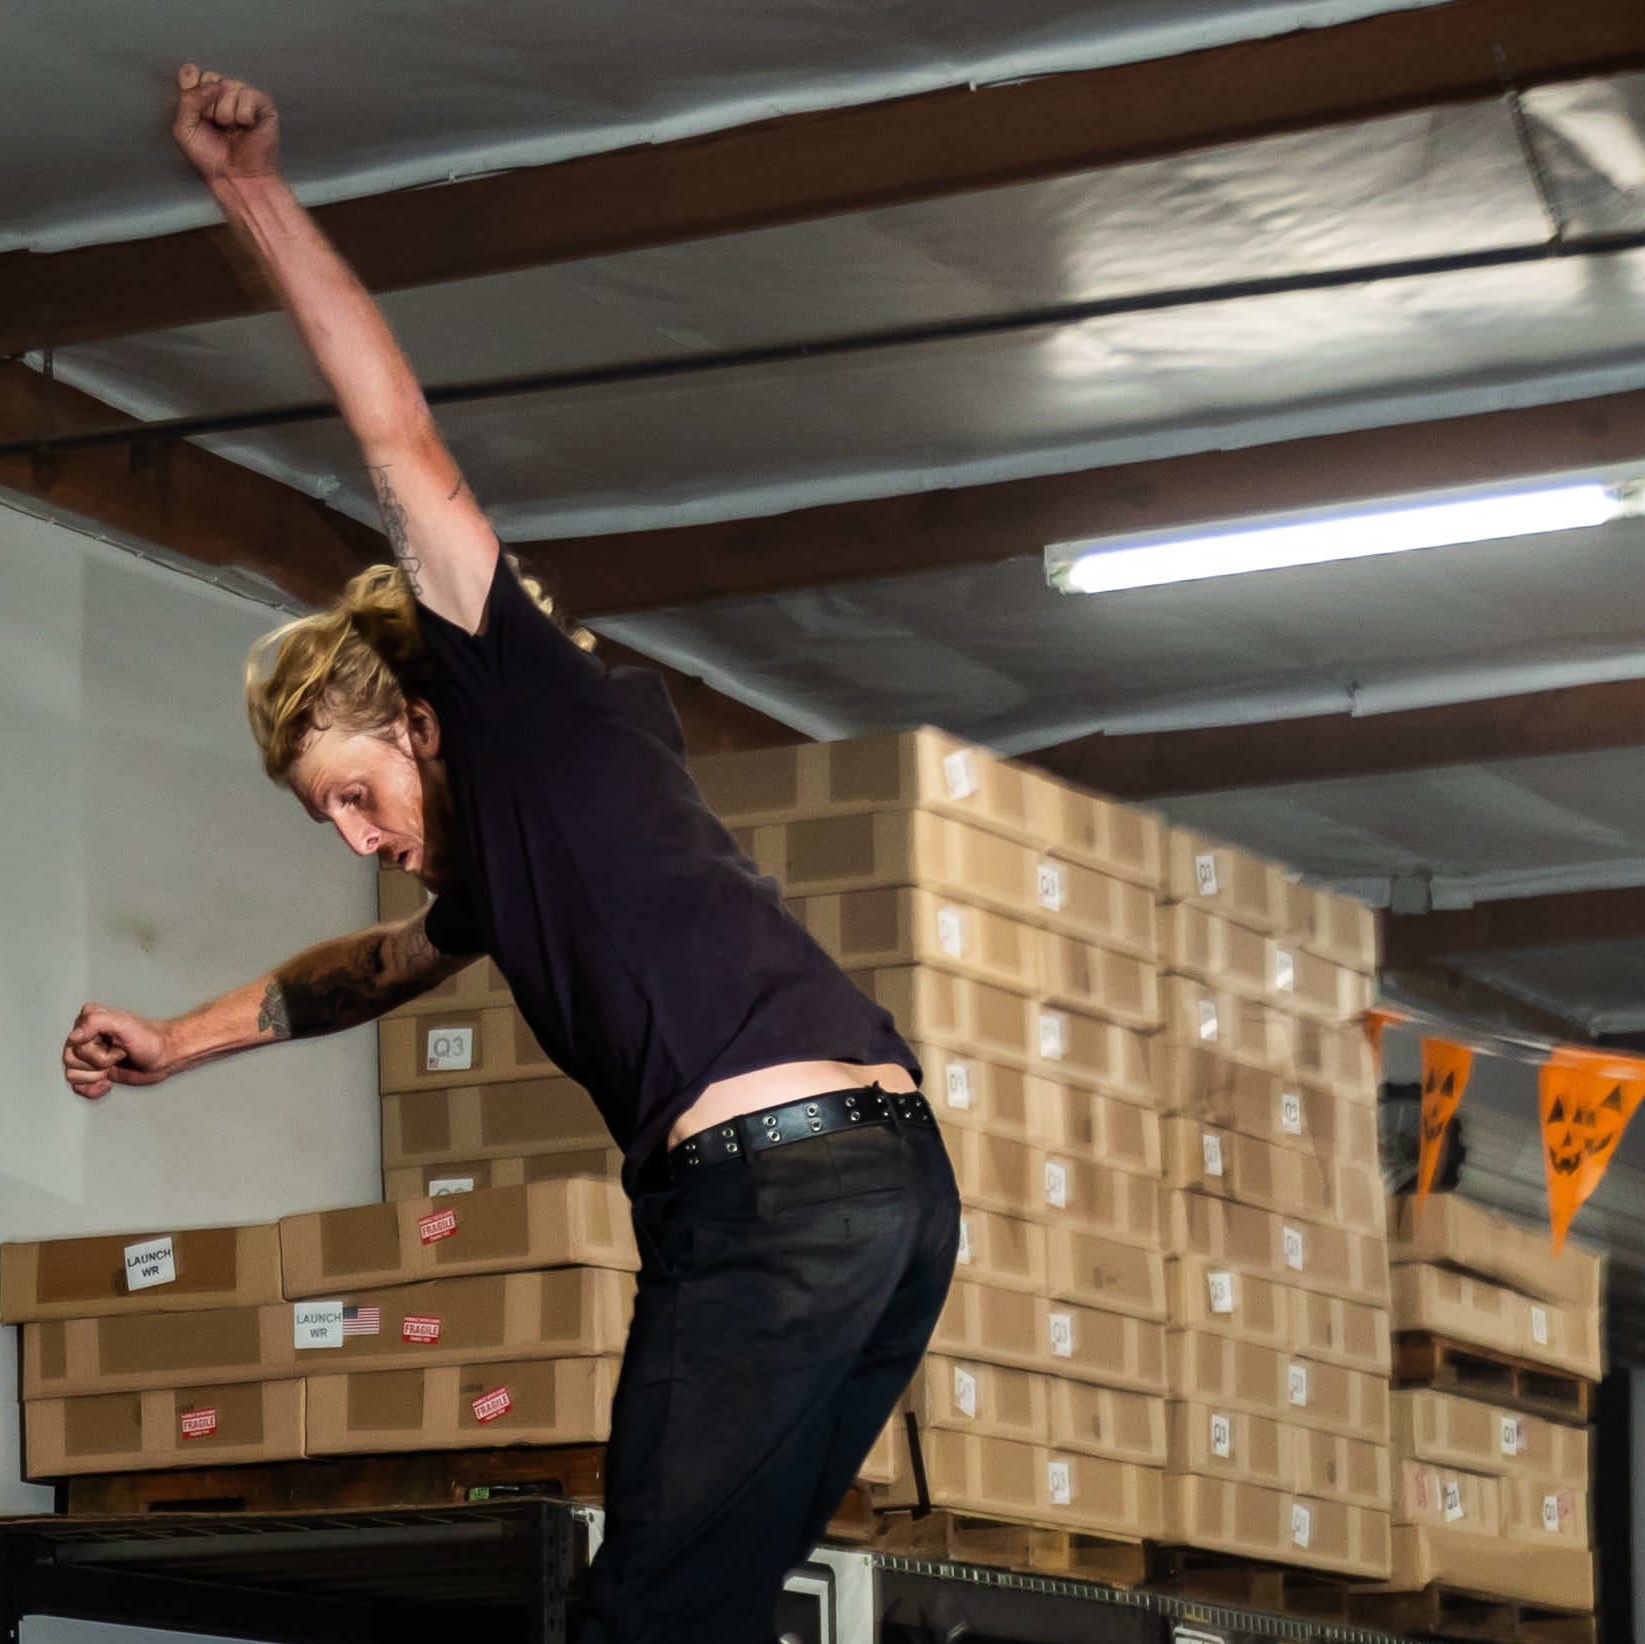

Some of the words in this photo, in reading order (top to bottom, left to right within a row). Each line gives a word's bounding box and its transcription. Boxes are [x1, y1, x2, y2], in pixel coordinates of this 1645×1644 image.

[433, 1036, 464, 1059] Q3
[421, 1217, 455, 1238] FRAGILE
[127, 1248, 172, 1268] LAUNCH
[141, 1265, 160, 1278] WR
[296, 1311, 343, 1325] LAUNCH
[309, 1327, 329, 1340] WR
[405, 1323, 439, 1336] FRAGILE
[476, 1395, 509, 1418] FRAGILE
